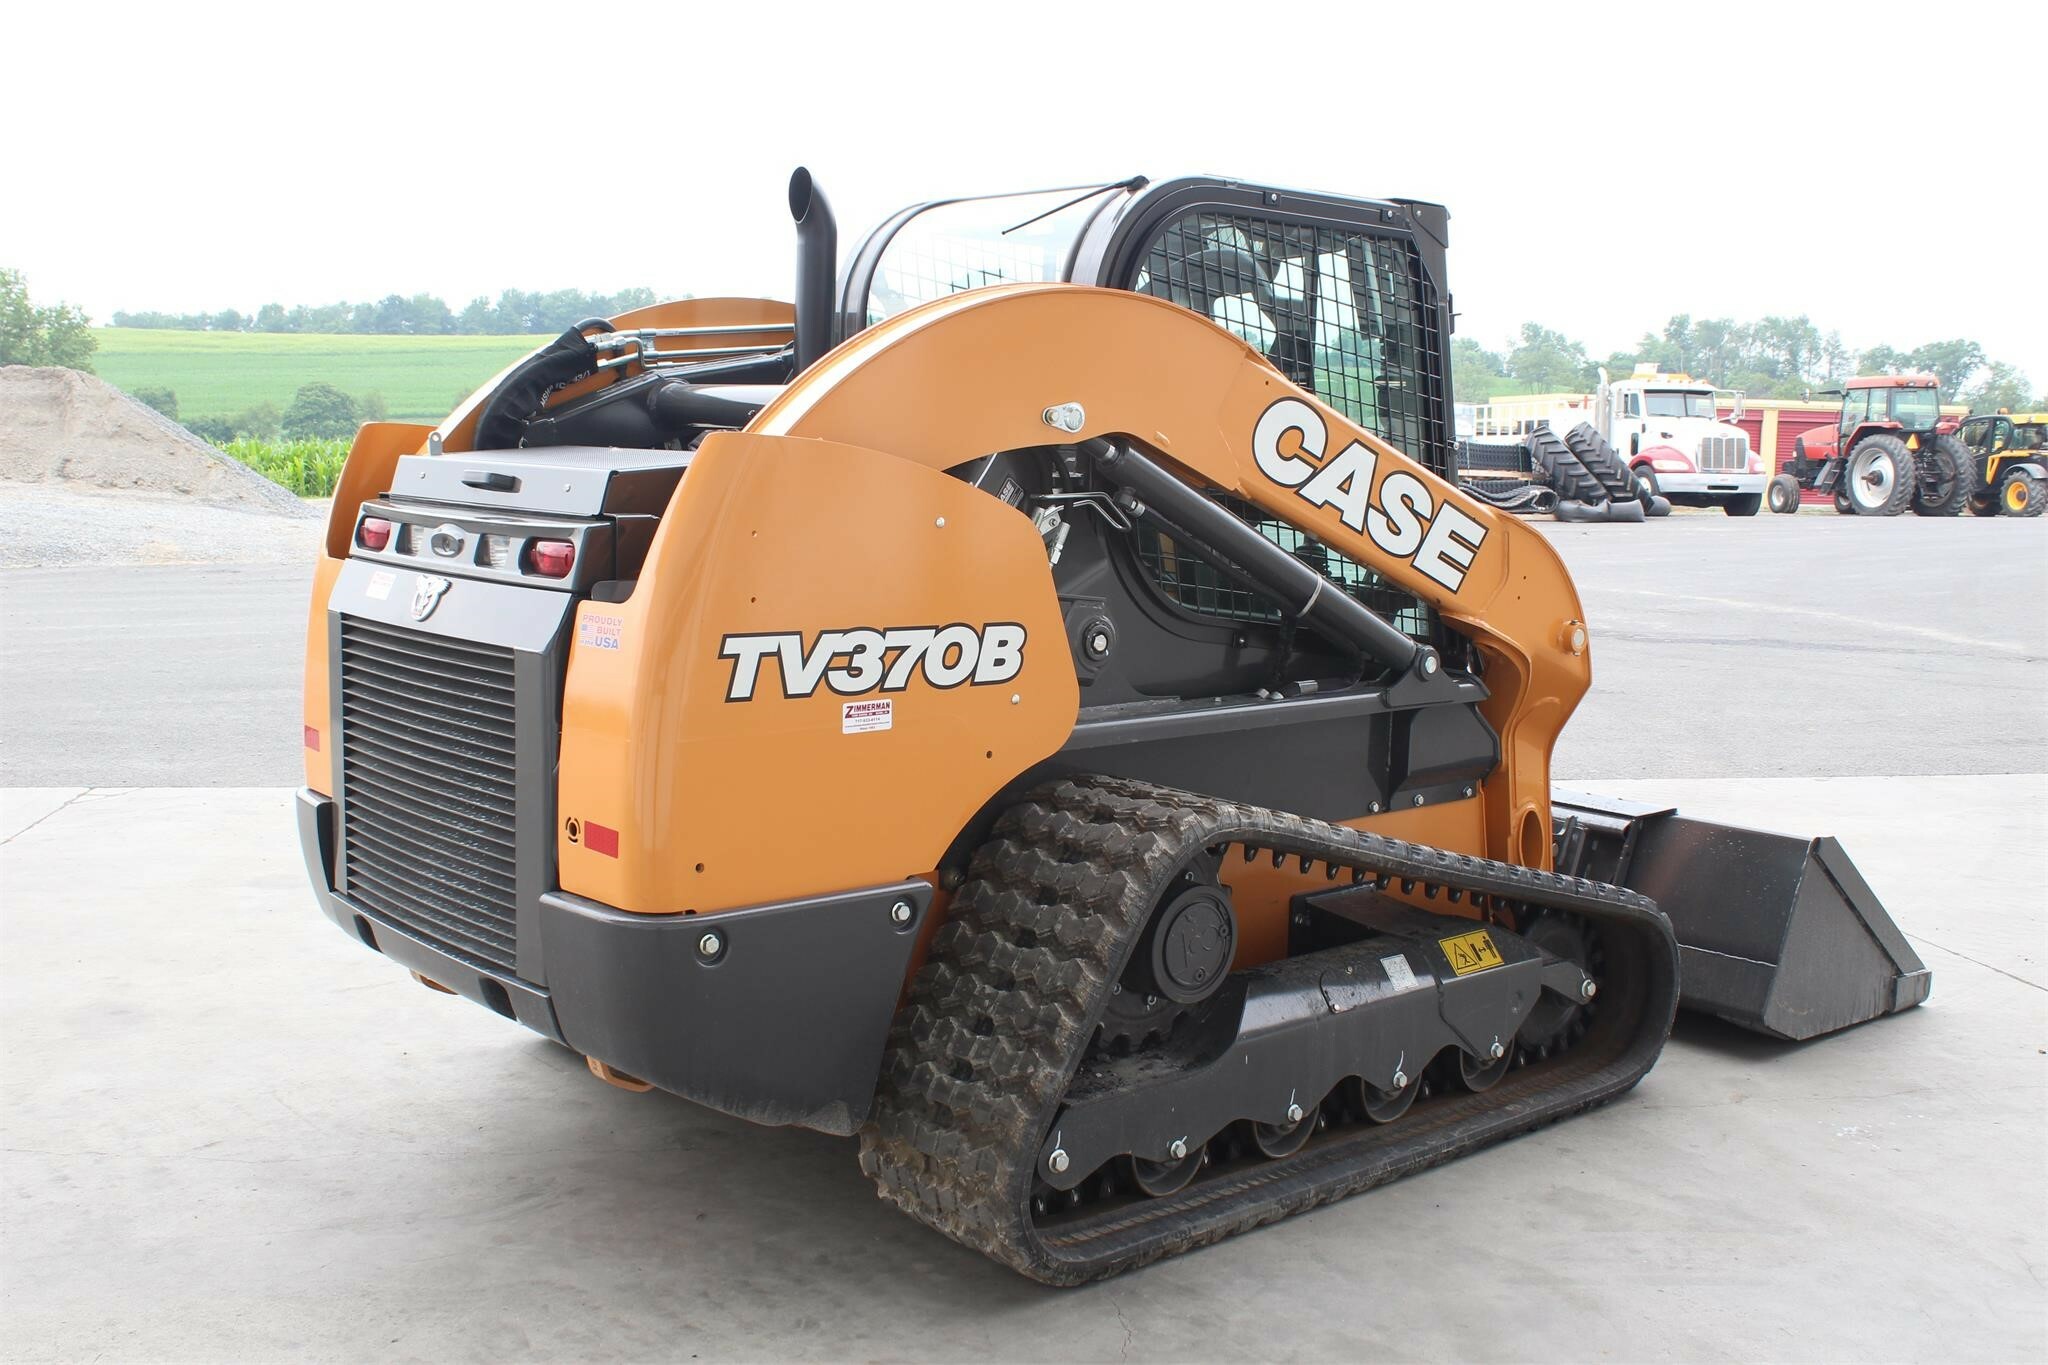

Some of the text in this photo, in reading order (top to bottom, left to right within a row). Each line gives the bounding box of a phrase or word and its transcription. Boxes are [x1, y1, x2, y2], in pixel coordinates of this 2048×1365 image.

[1252, 396, 1489, 594] CASE
[583, 614, 623, 626] PROUDLY
[597, 626, 622, 636] BUILT
[595, 636, 618, 649] USA
[718, 621, 1027, 703] TV370B
[845, 702, 891, 719] ZIMMERMAN
